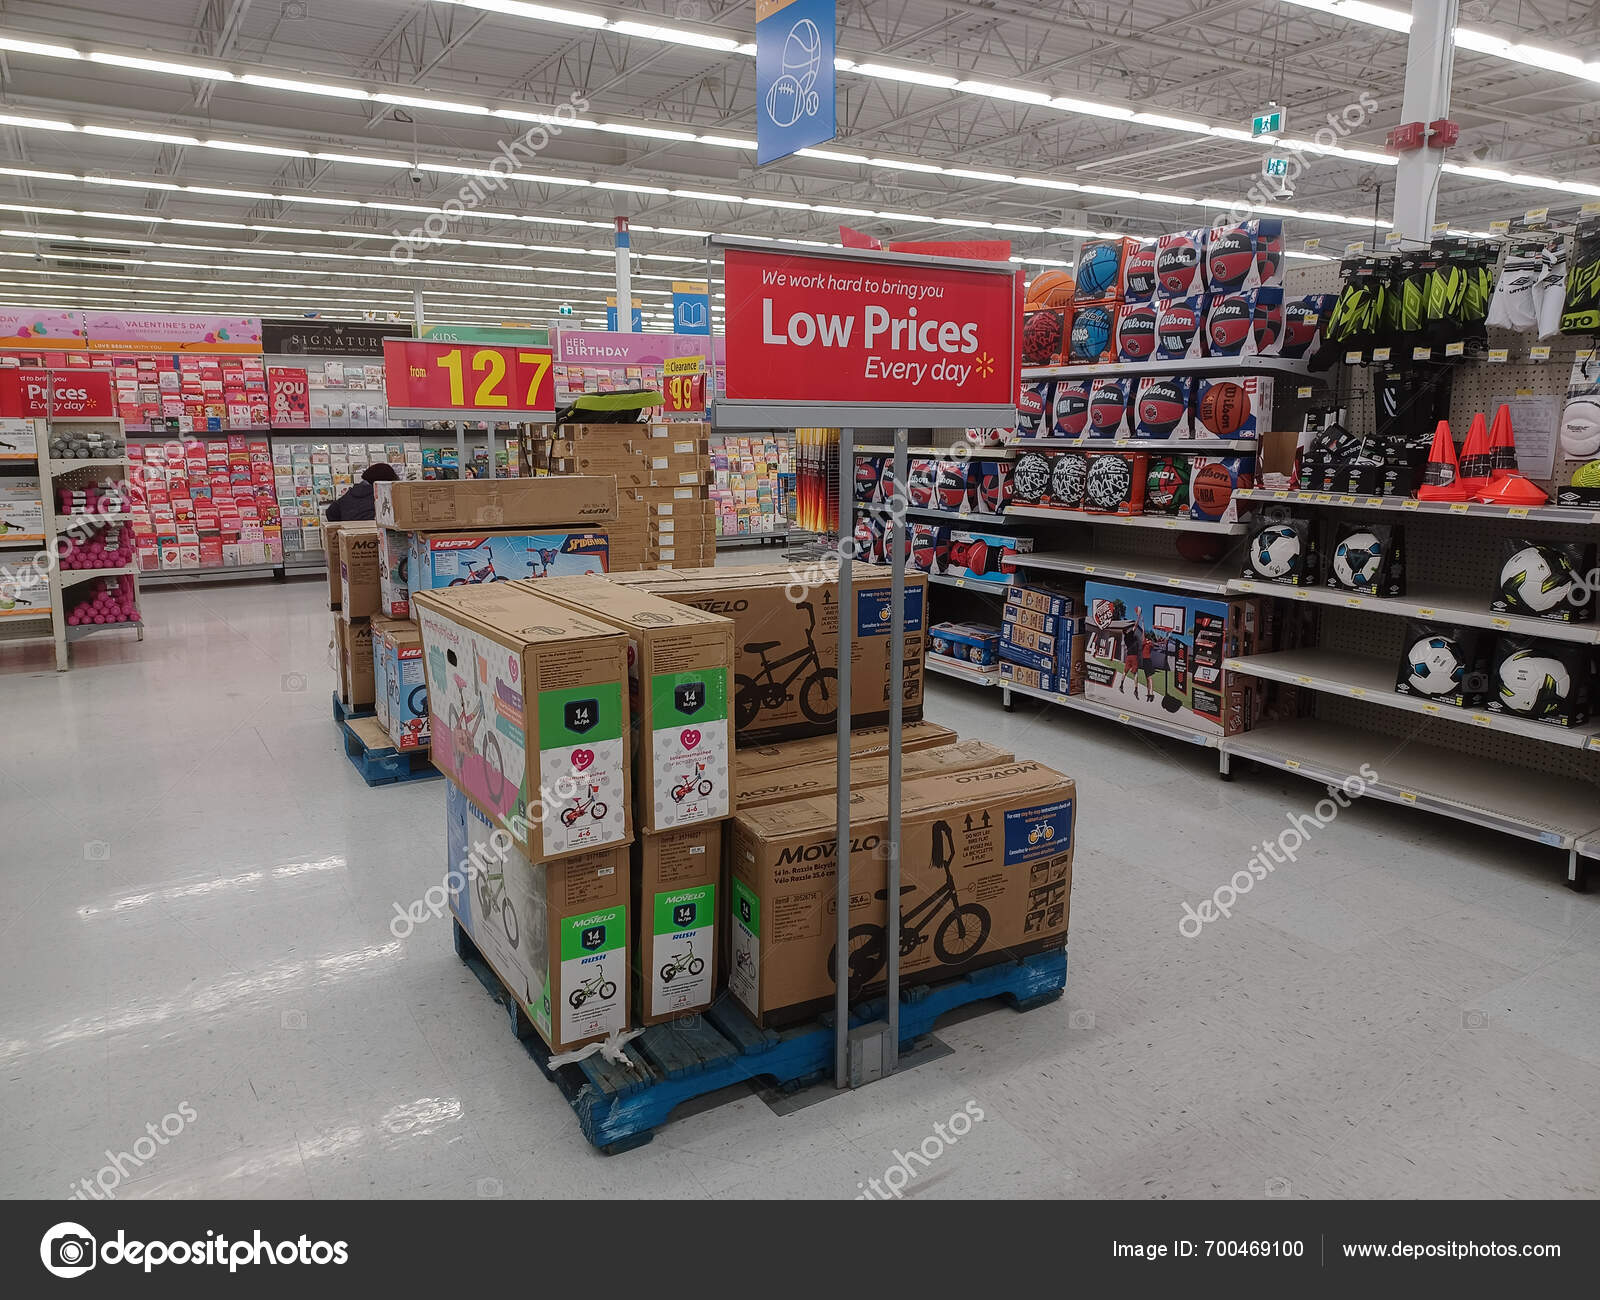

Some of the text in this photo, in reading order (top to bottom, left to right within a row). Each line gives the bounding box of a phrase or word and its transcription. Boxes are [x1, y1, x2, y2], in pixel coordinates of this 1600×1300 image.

[762, 269, 944, 301] We work hard to bring you
[125, 320, 187, 330] VALENTINE'S
[763, 298, 979, 354] Low Prices
[292, 334, 384, 347] SIGNATUR
[565, 337, 585, 346] HER
[566, 346, 629, 357] BIRTHDAY
[670, 360, 697, 374] Clearance
[864, 356, 972, 387] Every day
[409, 349, 552, 407] from 127
[273, 381, 305, 395] YOU
[63, 400, 85, 412] day
[435, 539, 477, 549] HUFFY
[684, 690, 696, 702] 14
[575, 707, 589, 719] 14
[665, 892, 706, 904] MOVELO
[679, 907, 691, 918] 14
[572, 913, 616, 929] MOVELO
[587, 929, 600, 941] 14
[672, 931, 697, 940] RUSH
[581, 953, 607, 965] RUSH
